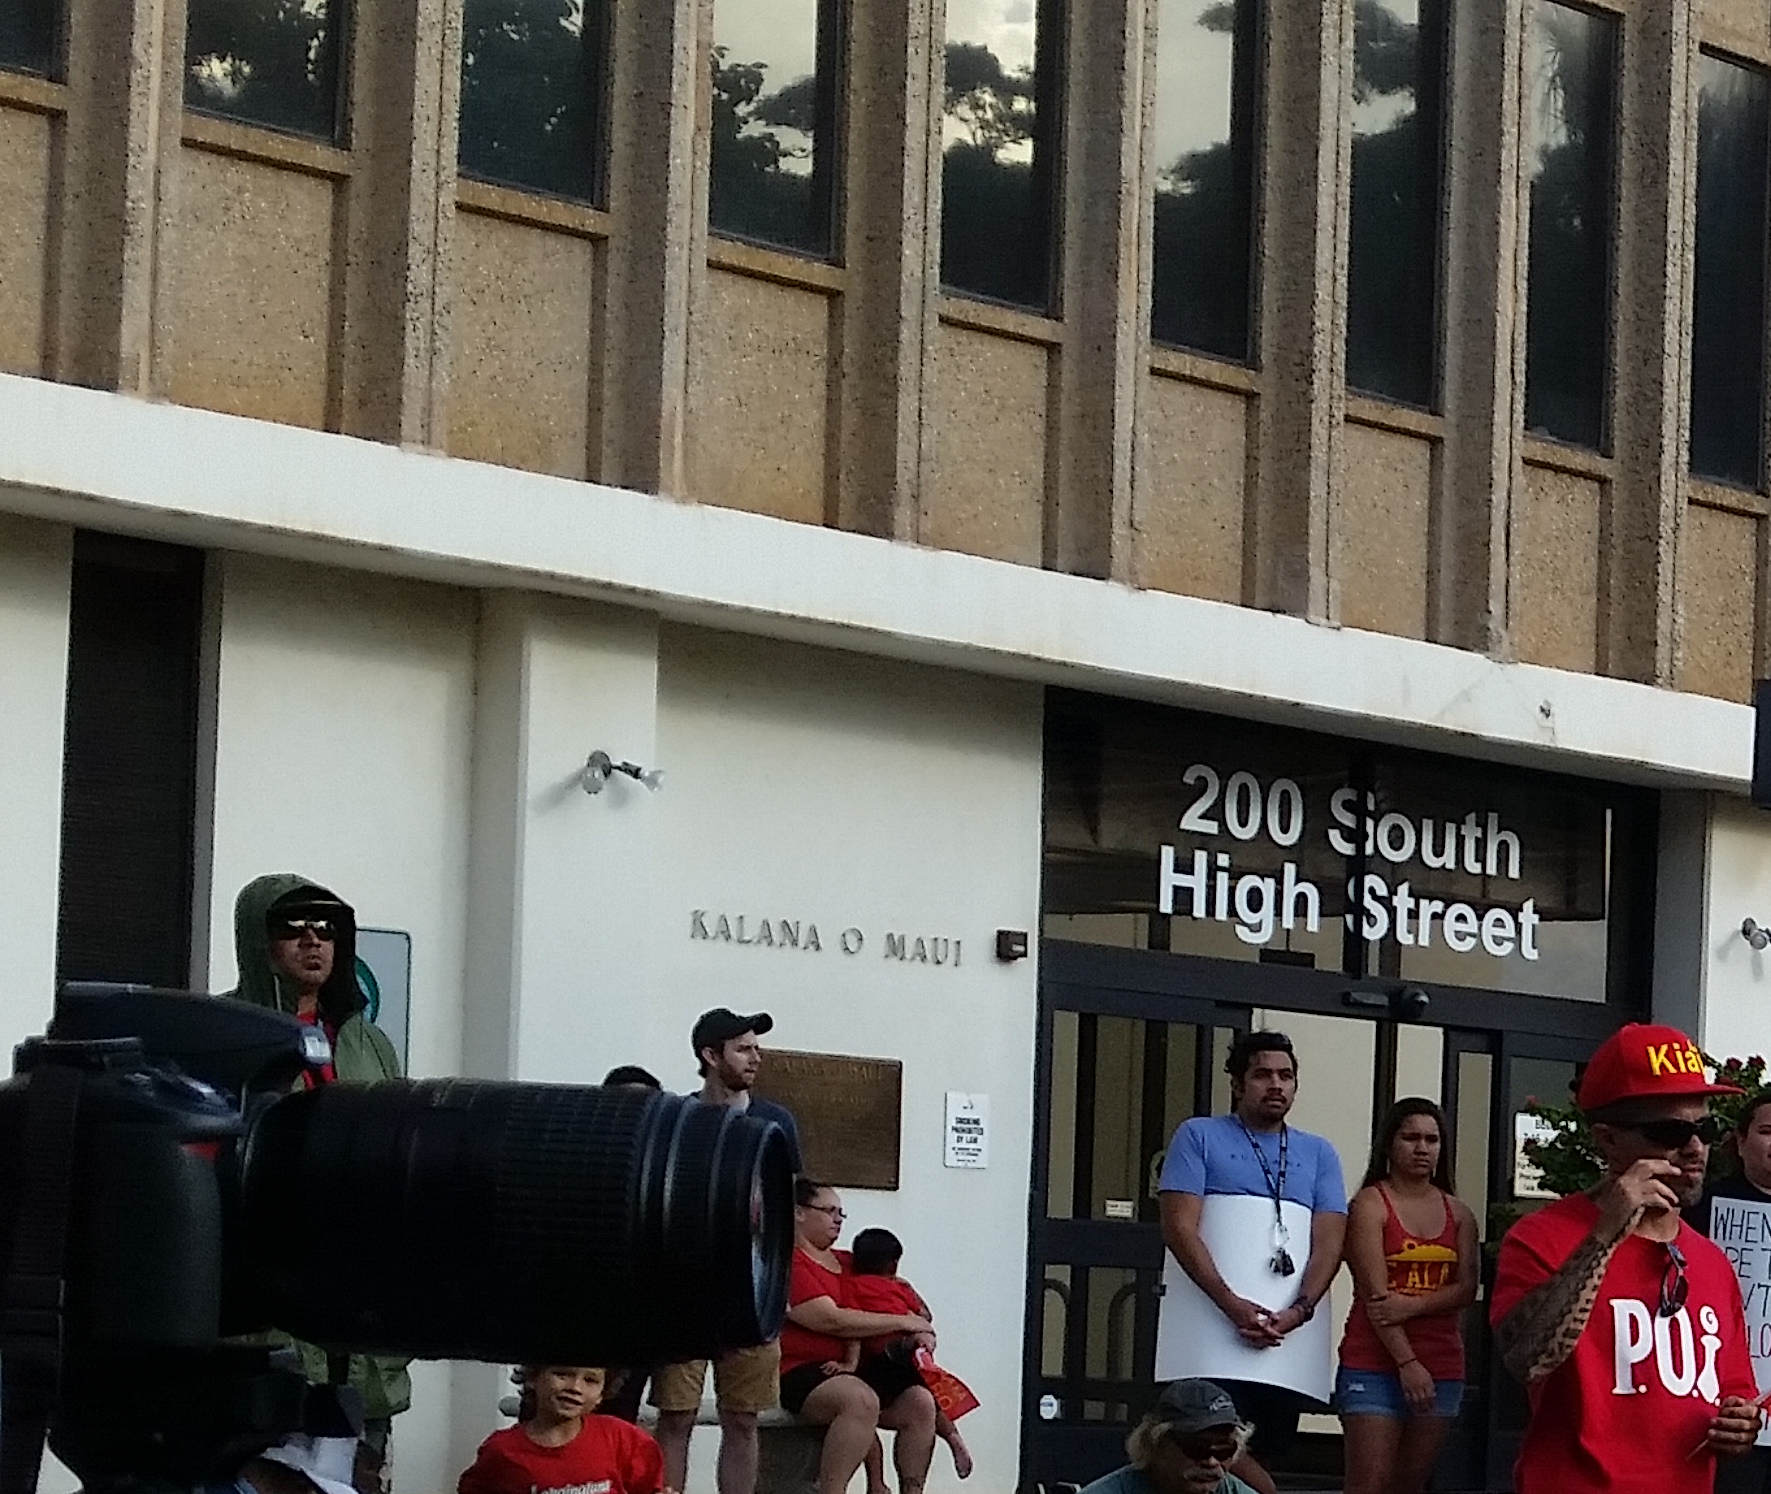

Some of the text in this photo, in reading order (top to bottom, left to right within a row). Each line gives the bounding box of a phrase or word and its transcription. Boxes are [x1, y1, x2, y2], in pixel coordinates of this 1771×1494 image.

[1179, 763, 1522, 880] 200 South
[690, 908, 962, 967] KALANA O MAUI
[1158, 844, 1541, 961] High Street
